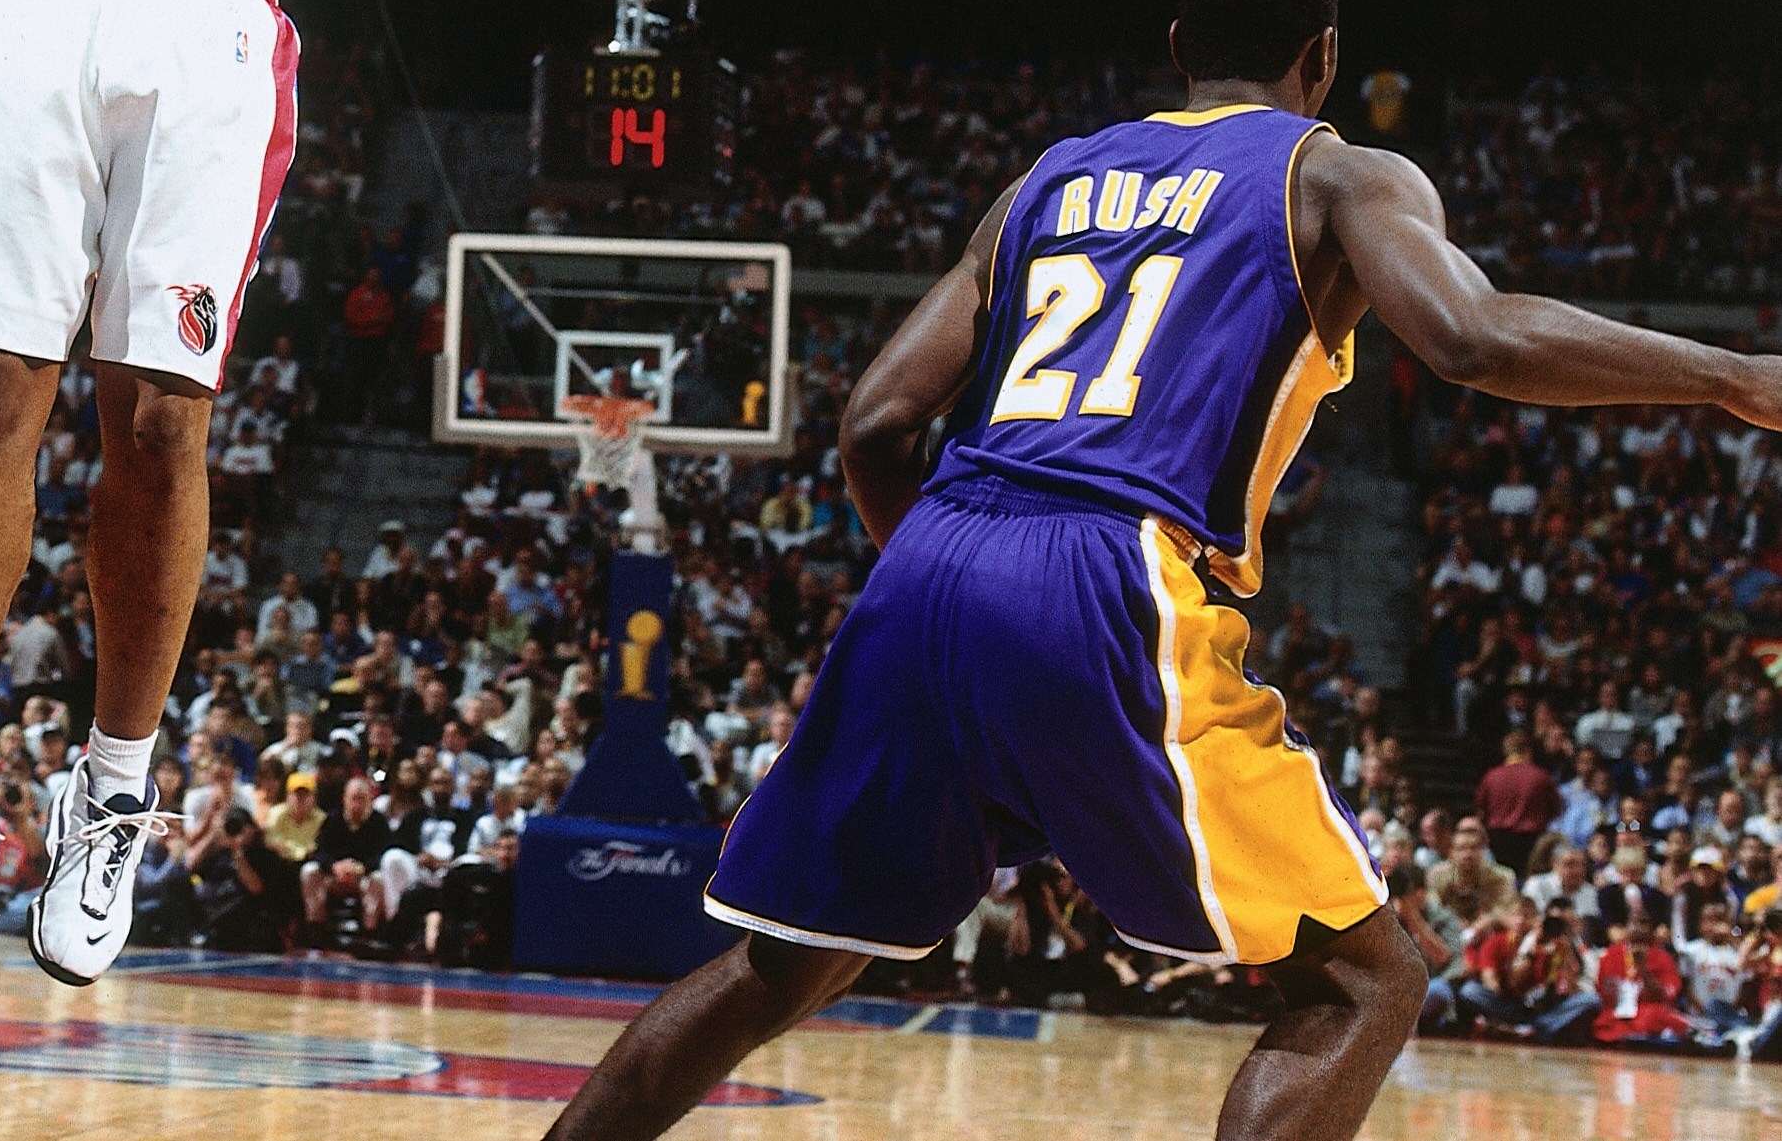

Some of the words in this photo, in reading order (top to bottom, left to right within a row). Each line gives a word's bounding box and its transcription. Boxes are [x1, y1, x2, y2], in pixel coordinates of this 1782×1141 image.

[610, 107, 666, 168] 14
[1056, 168, 1225, 237] RUSH
[989, 253, 1184, 427] 21
